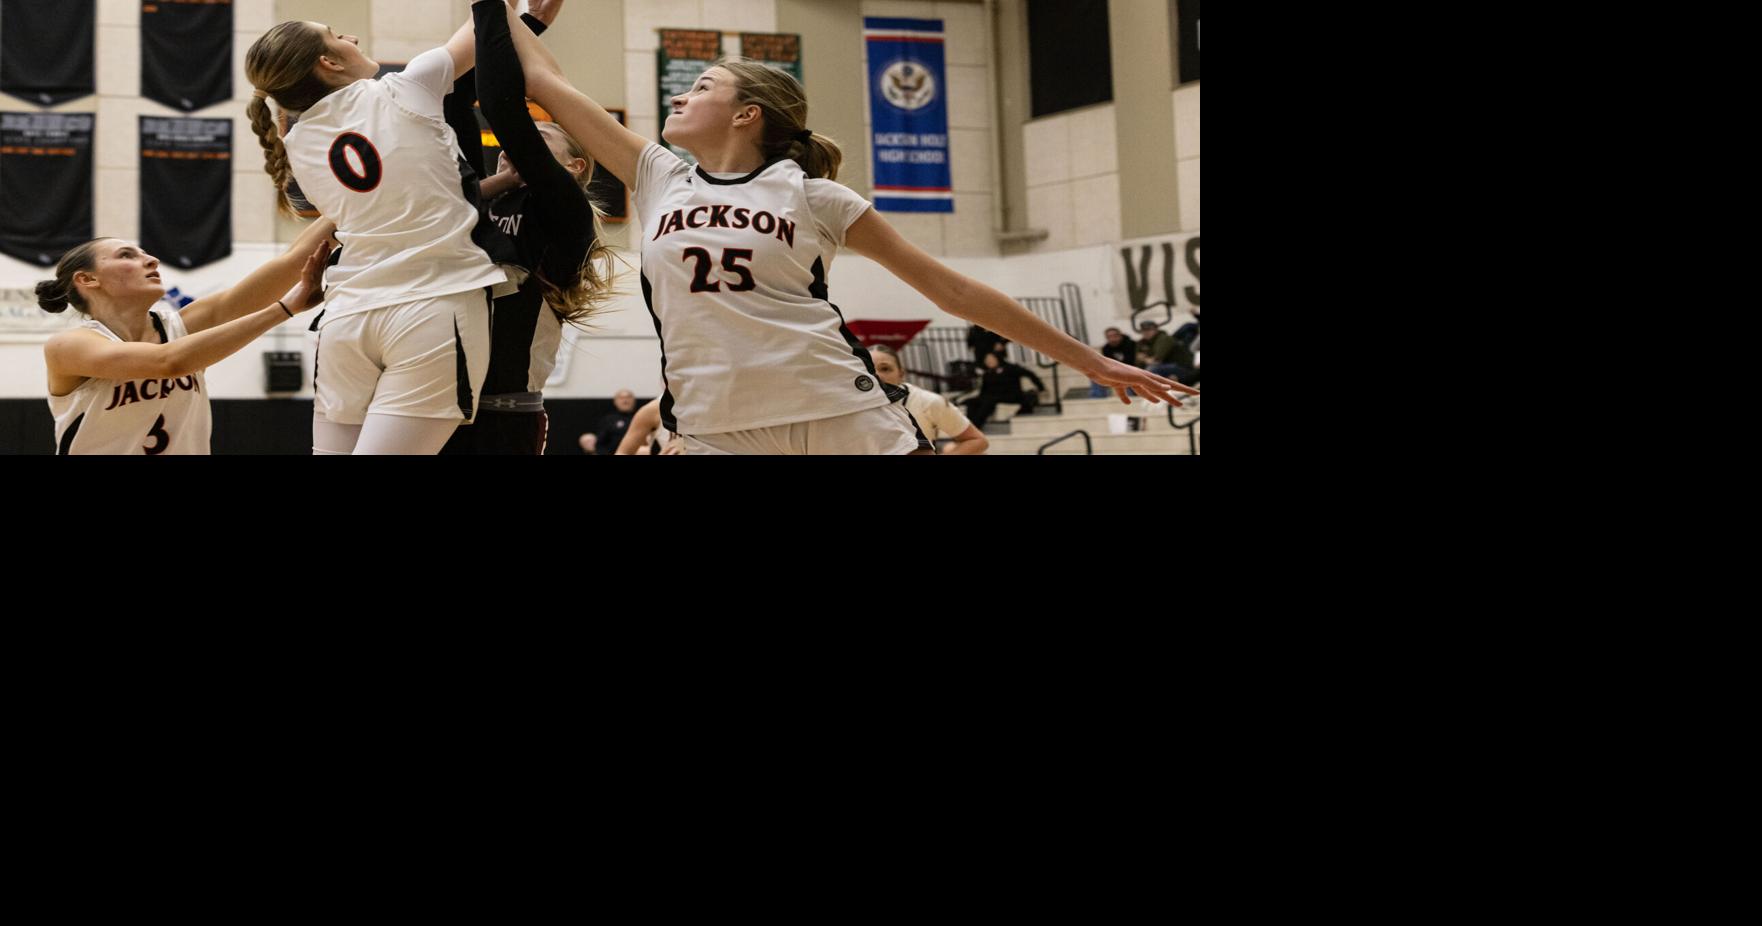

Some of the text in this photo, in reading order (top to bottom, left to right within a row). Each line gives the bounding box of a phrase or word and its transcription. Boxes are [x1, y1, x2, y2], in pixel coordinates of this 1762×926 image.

[328, 131, 383, 193] 0
[652, 204, 796, 249] JACKSON
[682, 246, 756, 293] 25
